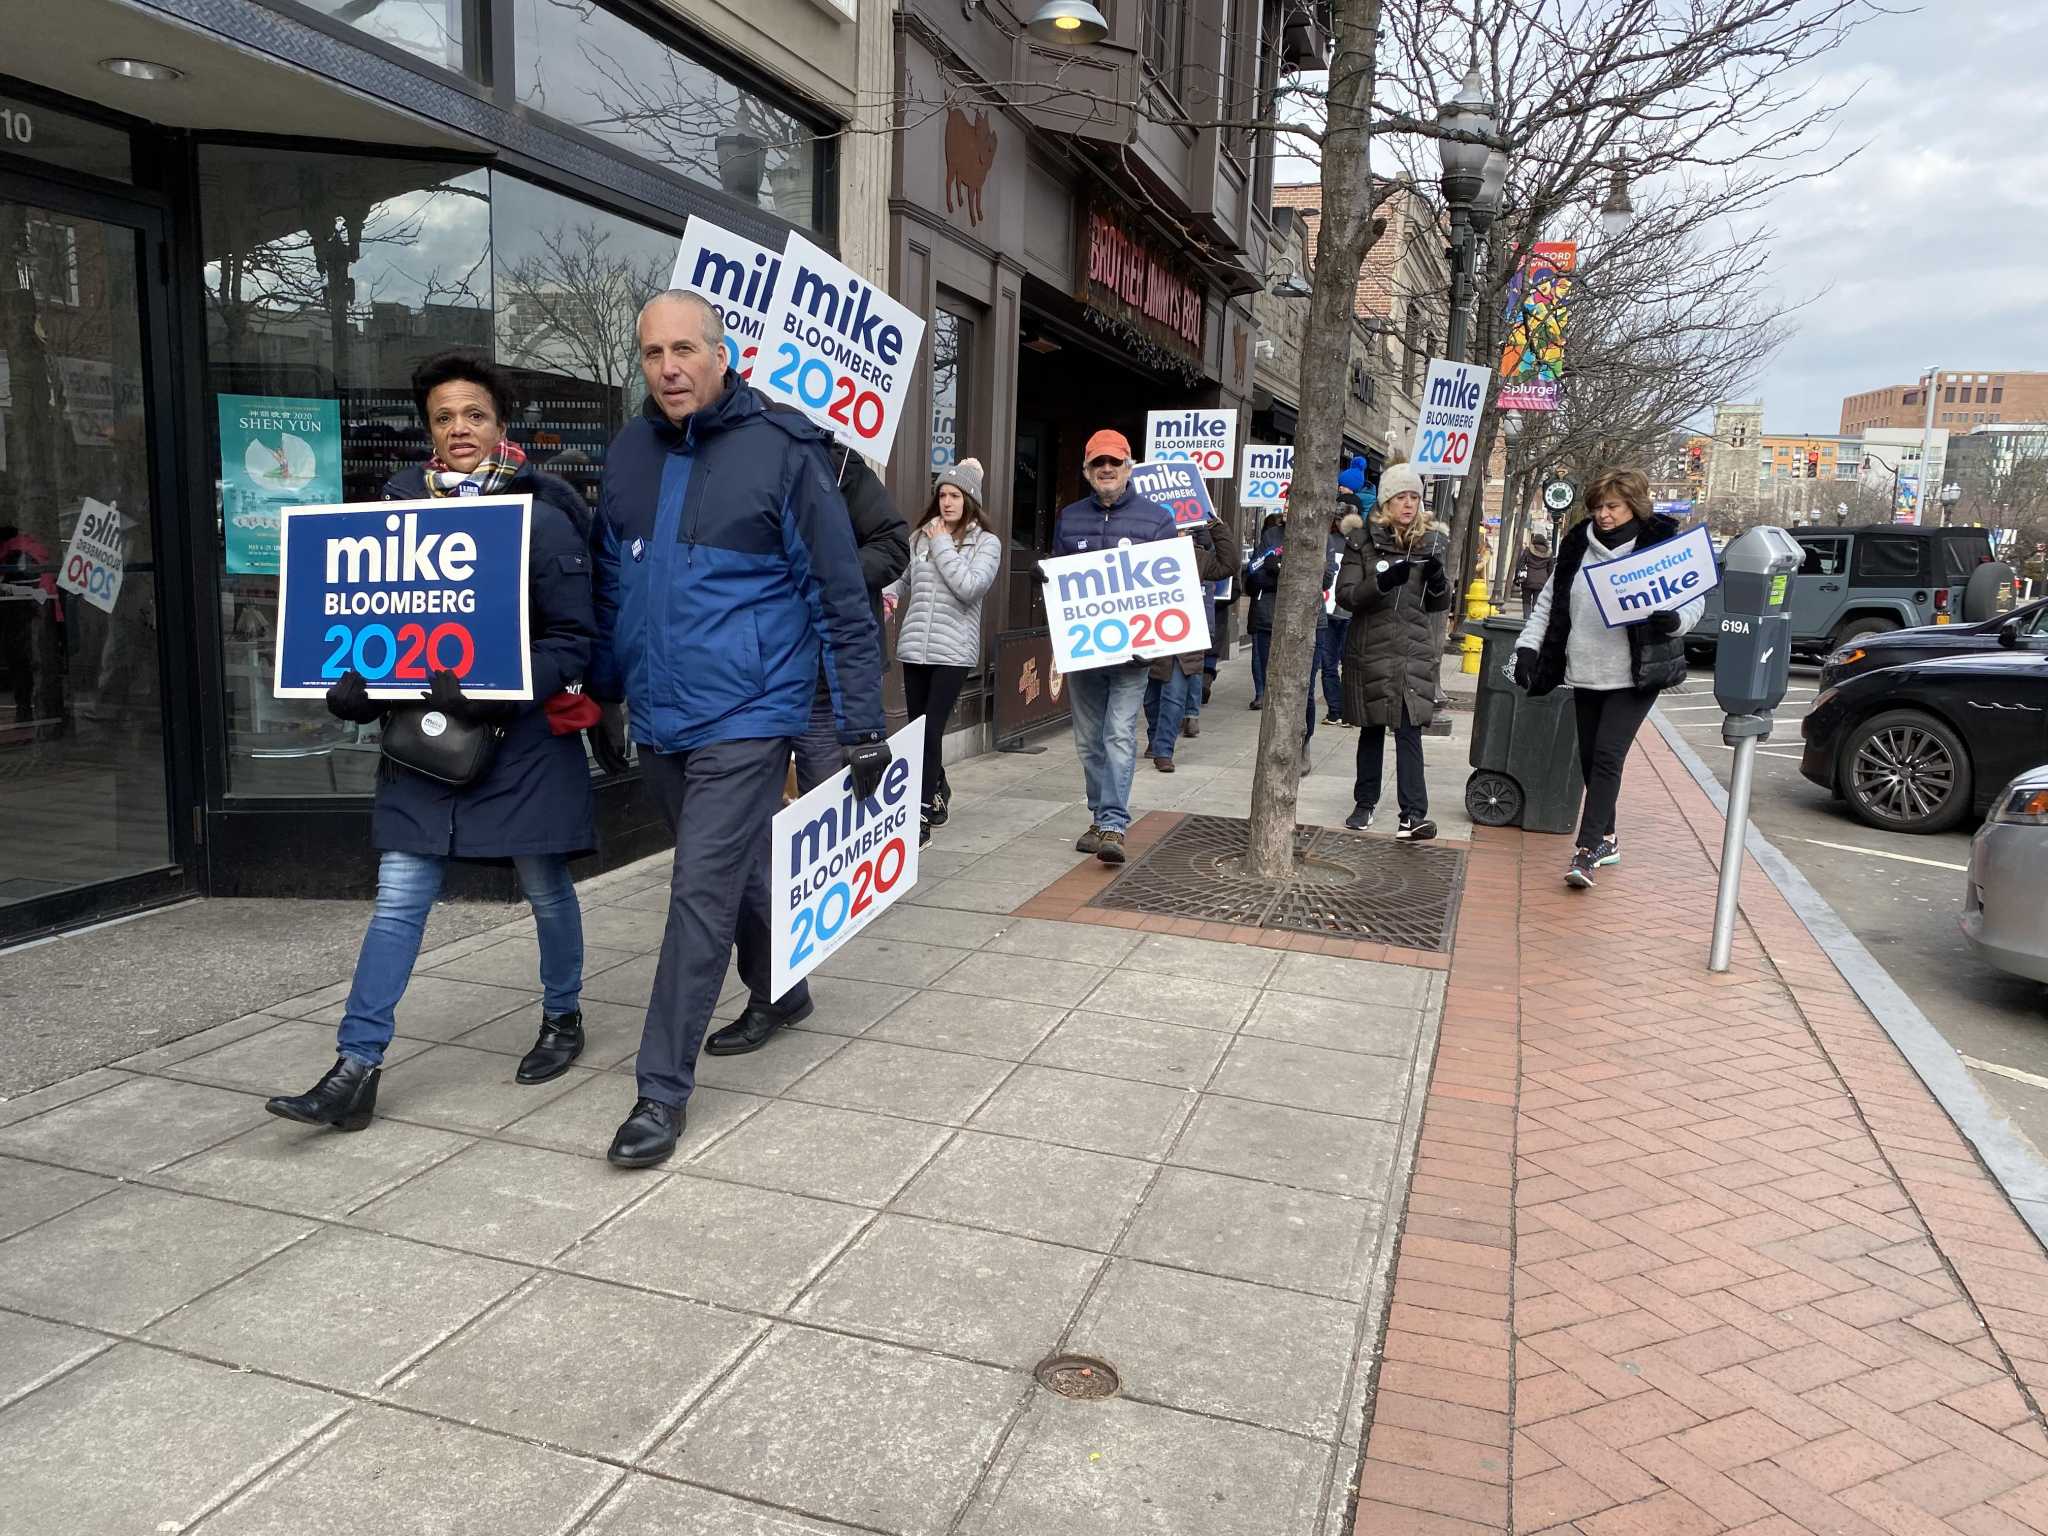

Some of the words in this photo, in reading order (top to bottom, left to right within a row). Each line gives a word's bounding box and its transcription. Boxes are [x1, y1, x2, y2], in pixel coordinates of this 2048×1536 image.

[1089, 222, 1145, 308] BROTHER
[790, 265, 903, 366] mike
[783, 312, 892, 393] BLOOMBERG
[769, 342, 885, 439] 2020
[1430, 368, 1480, 411] mike
[240, 418, 283, 430] SHEN
[288, 420, 321, 432] YUN
[1156, 413, 1226, 437] mike
[1426, 411, 1474, 429] BLOOMBERG
[1155, 440, 1225, 449] BLOOMBERG
[1251, 448, 1294, 469] mik
[1418, 430, 1469, 464] 2020
[1133, 464, 1191, 493] mike
[1248, 481, 1291, 498] 202
[1249, 471, 1292, 479] BLOOMB
[1149, 488, 1197, 503] OOMBERG
[326, 513, 477, 583] mike
[1058, 551, 1182, 602] mike
[1610, 548, 1694, 586] Connecticut
[324, 589, 475, 615] BLOOMBERG
[1063, 589, 1185, 621] BLOOMBERG
[1618, 570, 1700, 610] mike
[1067, 608, 1191, 659] 2020
[1721, 620, 1750, 634] 619A
[321, 622, 475, 680] 2020
[790, 804, 907, 911] BLOOMBERG
[789, 837, 906, 969] 2020
